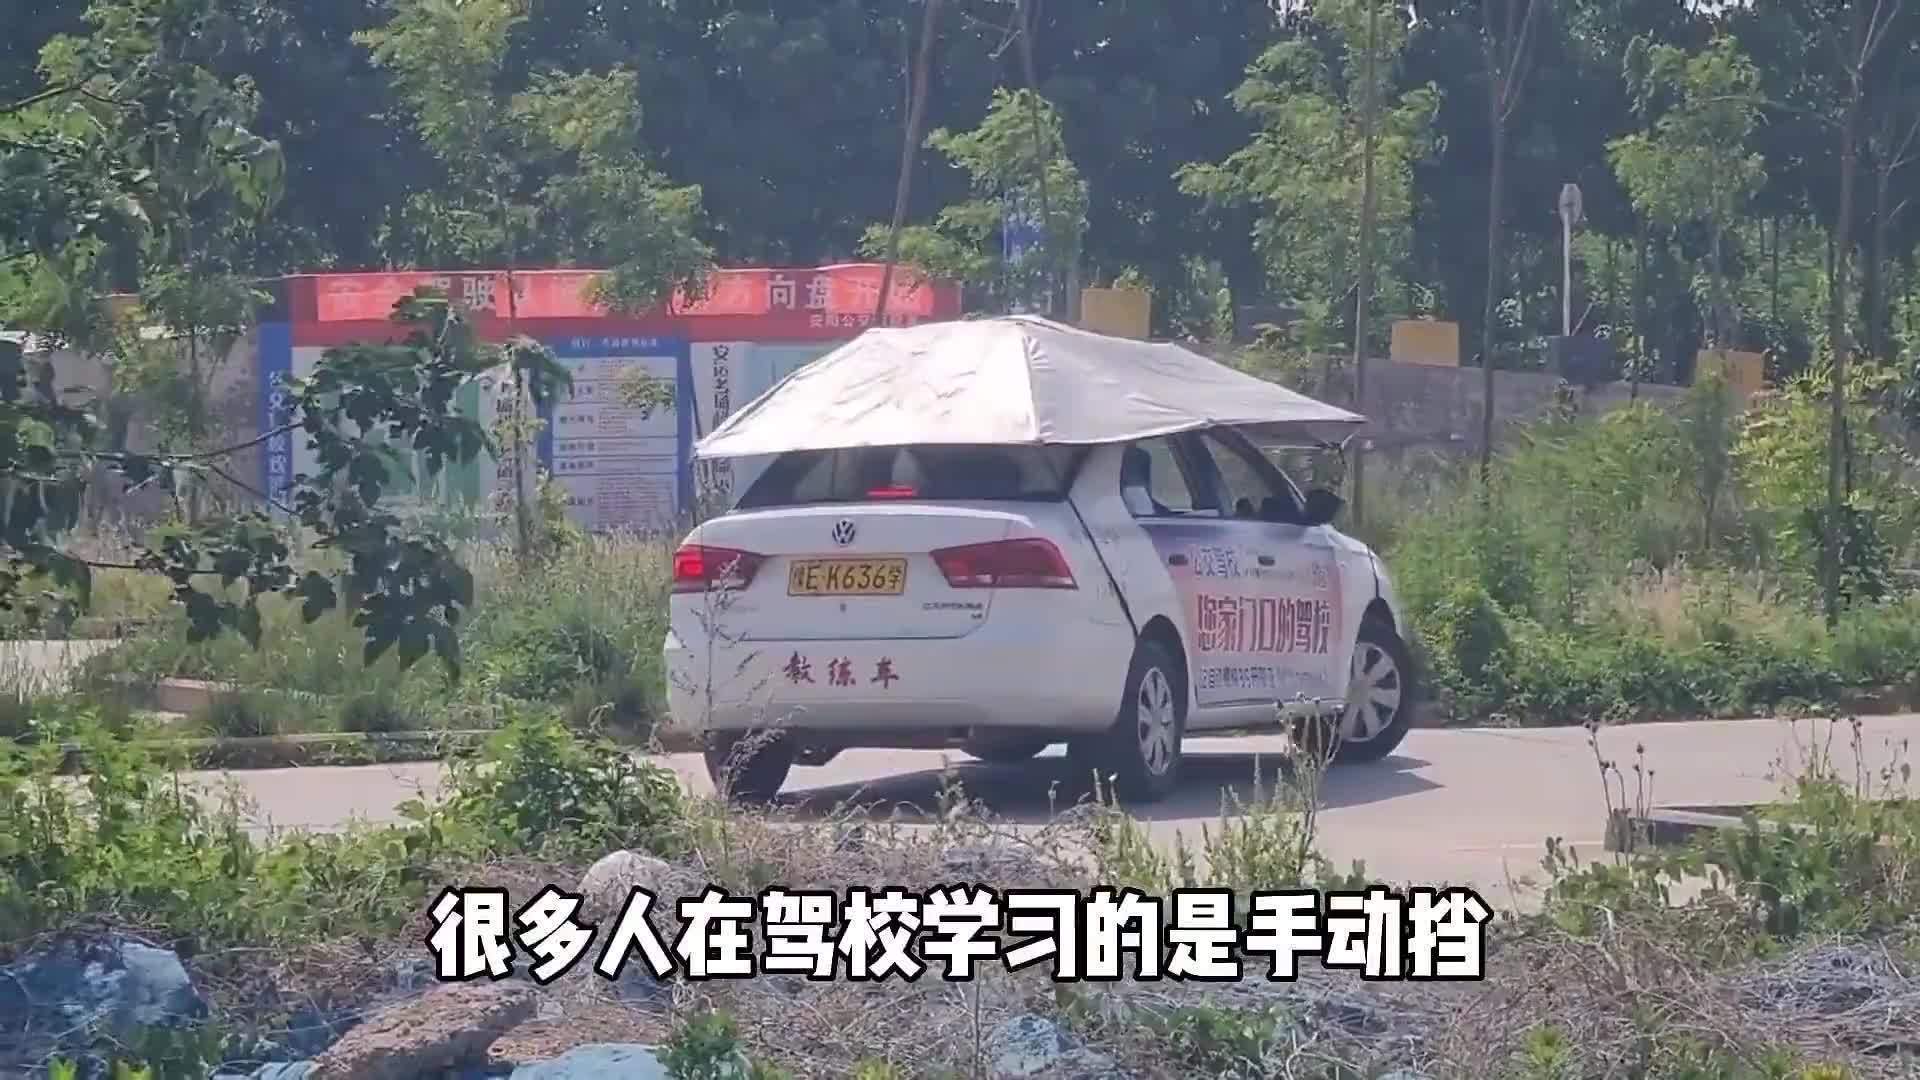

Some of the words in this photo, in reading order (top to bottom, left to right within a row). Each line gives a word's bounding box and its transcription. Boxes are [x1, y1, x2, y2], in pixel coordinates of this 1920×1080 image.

[1197, 594, 1330, 654] 您家门口的驾校
[783, 650, 900, 689] 教练车
